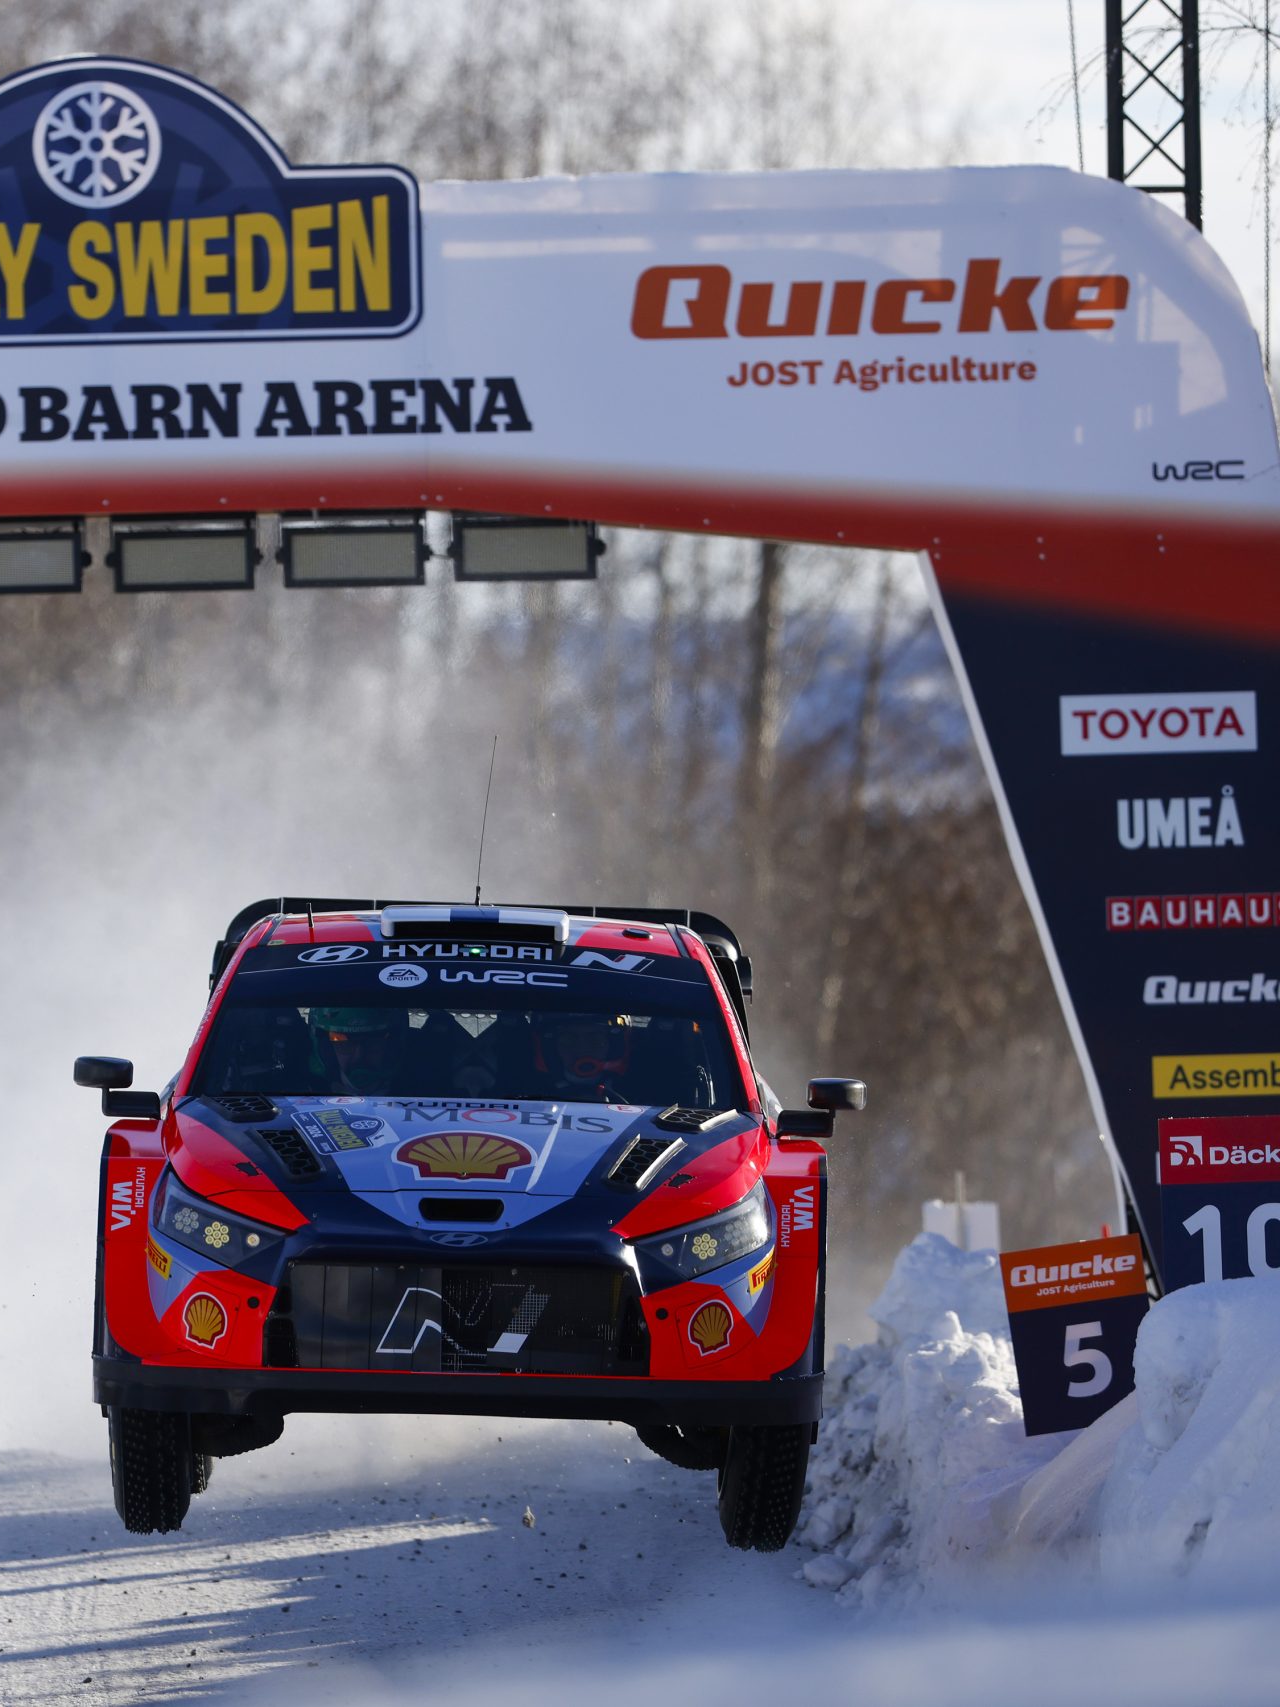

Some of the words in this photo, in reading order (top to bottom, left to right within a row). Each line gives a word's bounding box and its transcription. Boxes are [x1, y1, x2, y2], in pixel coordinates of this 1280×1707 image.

[67, 194, 392, 321] SWEDEN
[630, 258, 1130, 340] Quicke
[727, 360, 822, 388] JOST
[834, 356, 1037, 392] Agriculture
[19, 382, 243, 442] BARN
[254, 377, 533, 439] ARENA
[1152, 460, 1244, 482] WRC
[1073, 707, 1244, 740] TOYOTA
[1117, 785, 1244, 849] UMEÅ
[1111, 898, 1280, 927] BAUHAU
[440, 968, 568, 987] WRC
[1143, 973, 1280, 1004] Quick
[403, 1108, 613, 1133] MOBIS
[1210, 1143, 1280, 1166] Däck
[135, 1167, 146, 1208] HYUNDAI
[781, 1205, 790, 1248] HYUNDAI
[1010, 1254, 1136, 1288] Quicke
[1037, 1286, 1061, 1297] JOST
[1063, 1279, 1116, 1294] Agriculture
[1064, 1321, 1113, 1398] 5
